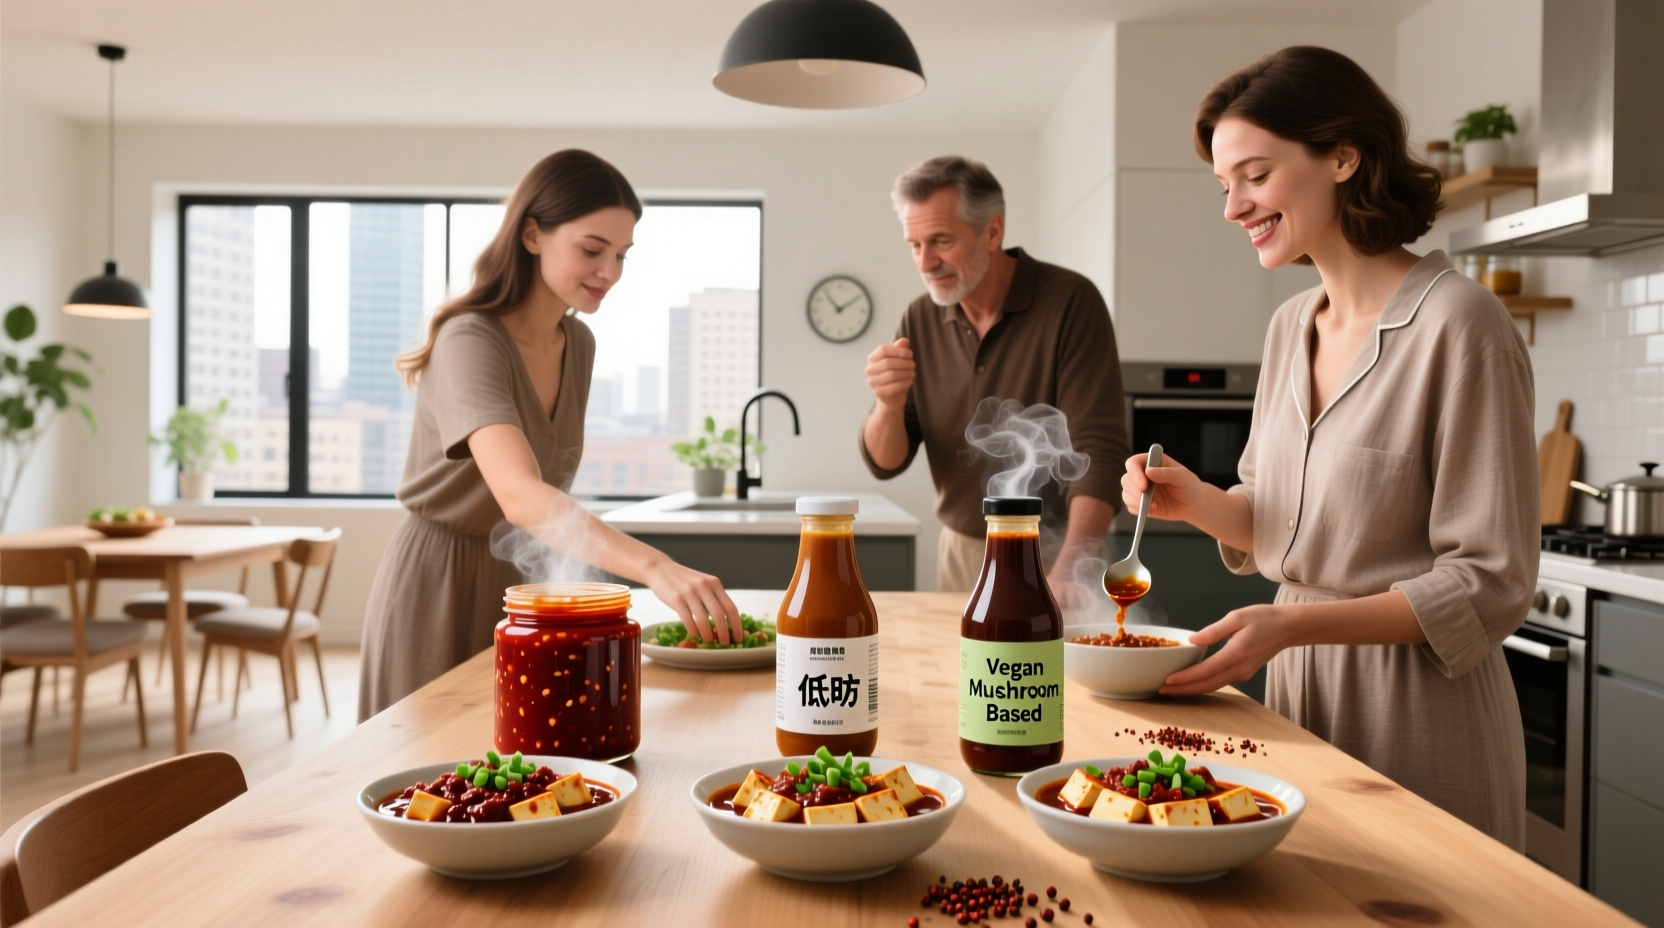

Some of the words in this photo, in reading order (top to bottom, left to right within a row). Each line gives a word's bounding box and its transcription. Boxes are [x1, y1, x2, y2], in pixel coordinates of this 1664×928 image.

[986, 658, 1044, 681] Vegan
[969, 678, 1059, 699] Mushroom
[986, 703, 1042, 722] Based
